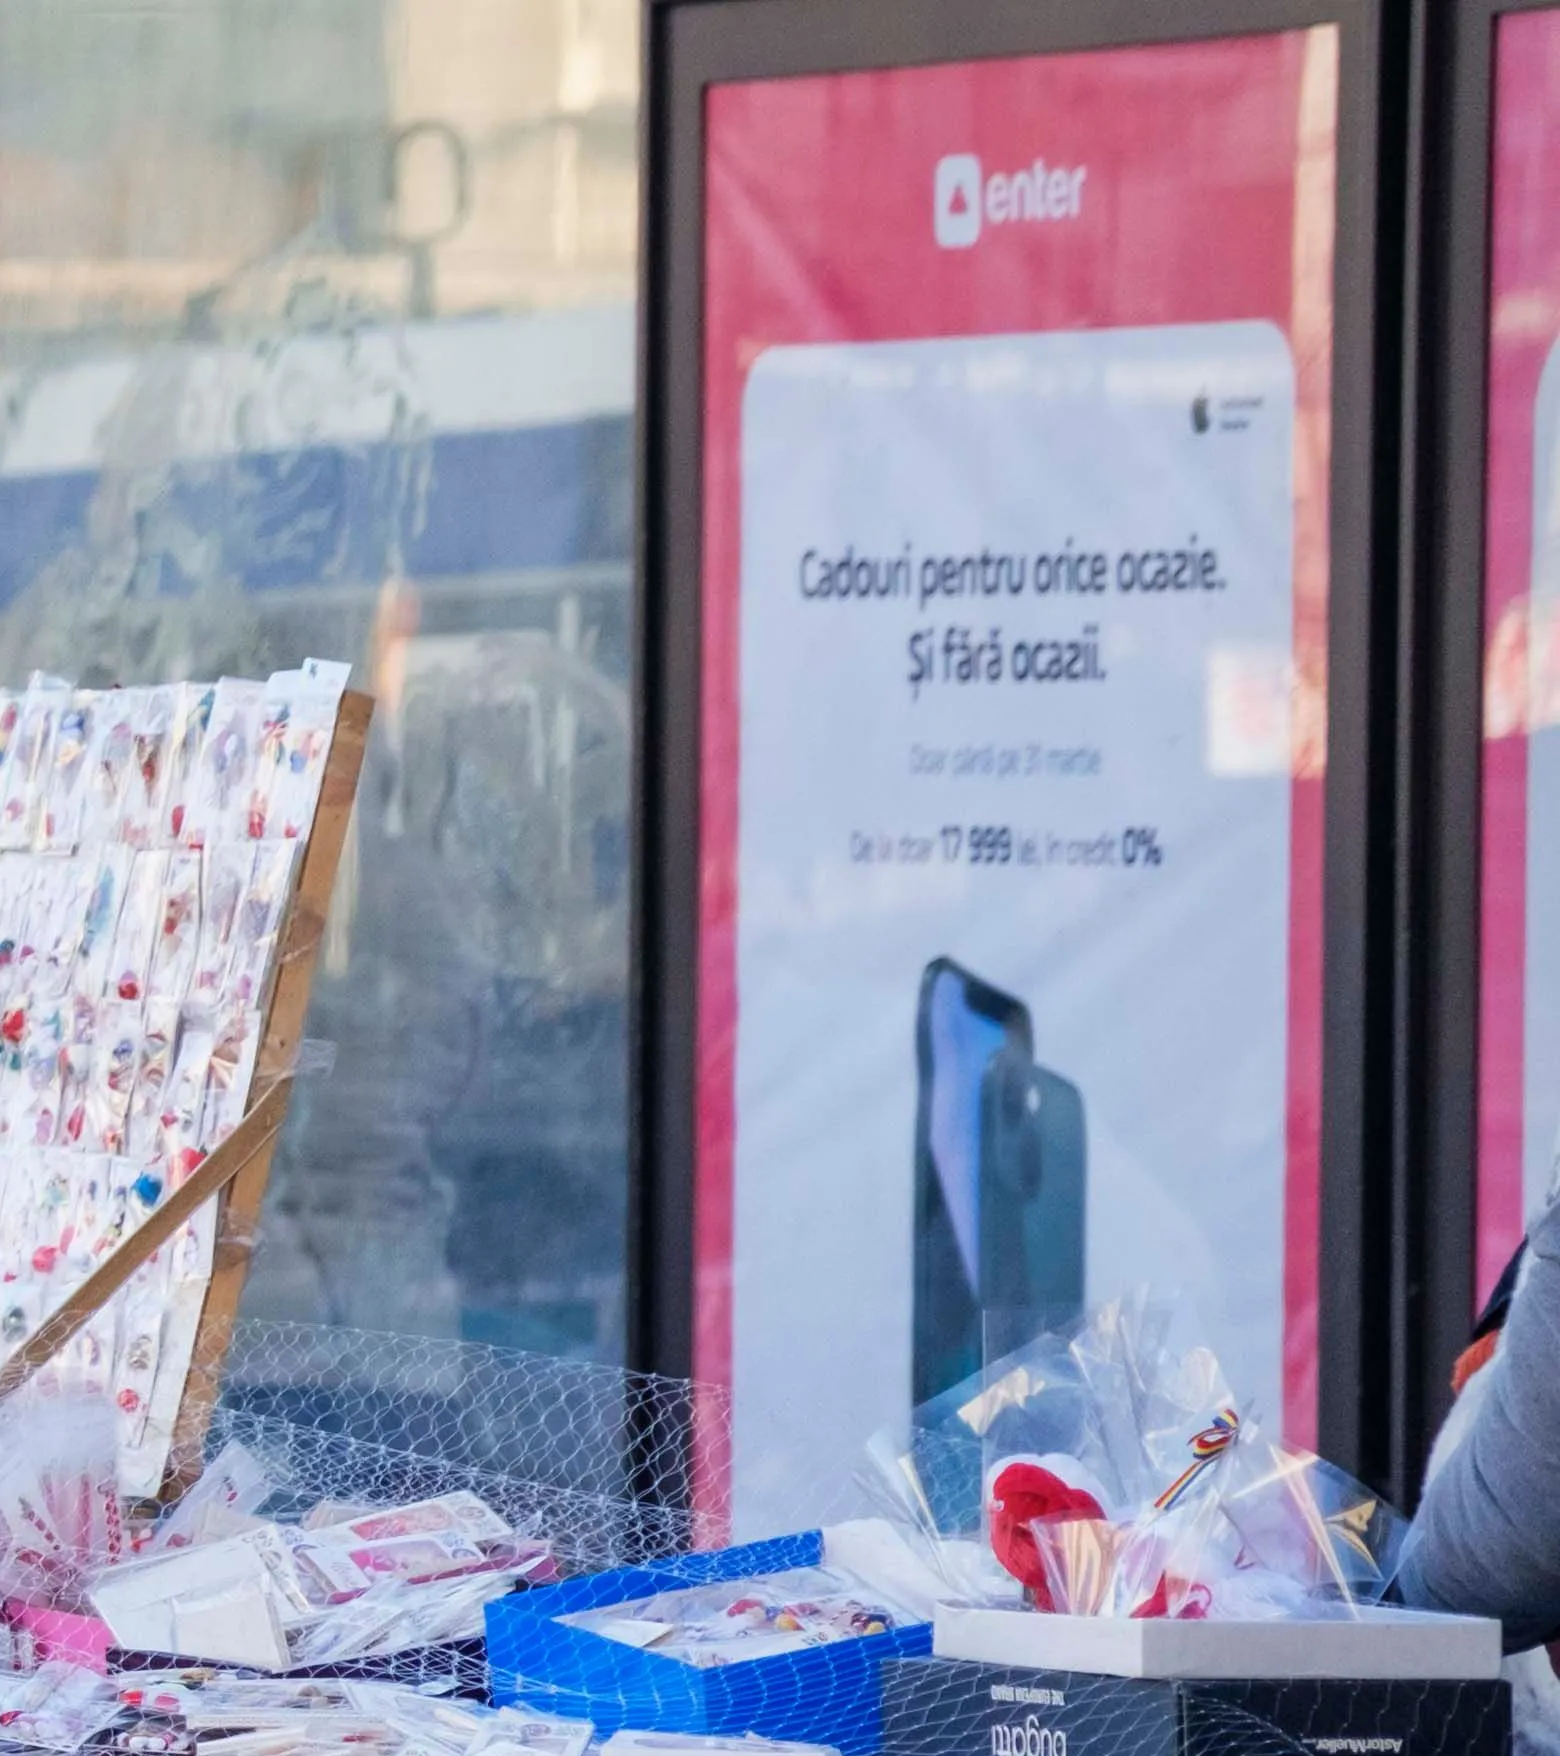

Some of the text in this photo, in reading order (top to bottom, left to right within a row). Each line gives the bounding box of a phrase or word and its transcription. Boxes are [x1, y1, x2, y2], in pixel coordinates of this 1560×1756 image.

[985, 157, 1087, 225] enter
[800, 533, 1226, 611] Cadouri pentru orice ocazie.
[942, 624, 1003, 683] fără
[1011, 623, 1107, 682] ocazii.
[939, 825, 962, 863] 17
[968, 824, 1012, 865] 999
[1122, 825, 1163, 866] 0%
